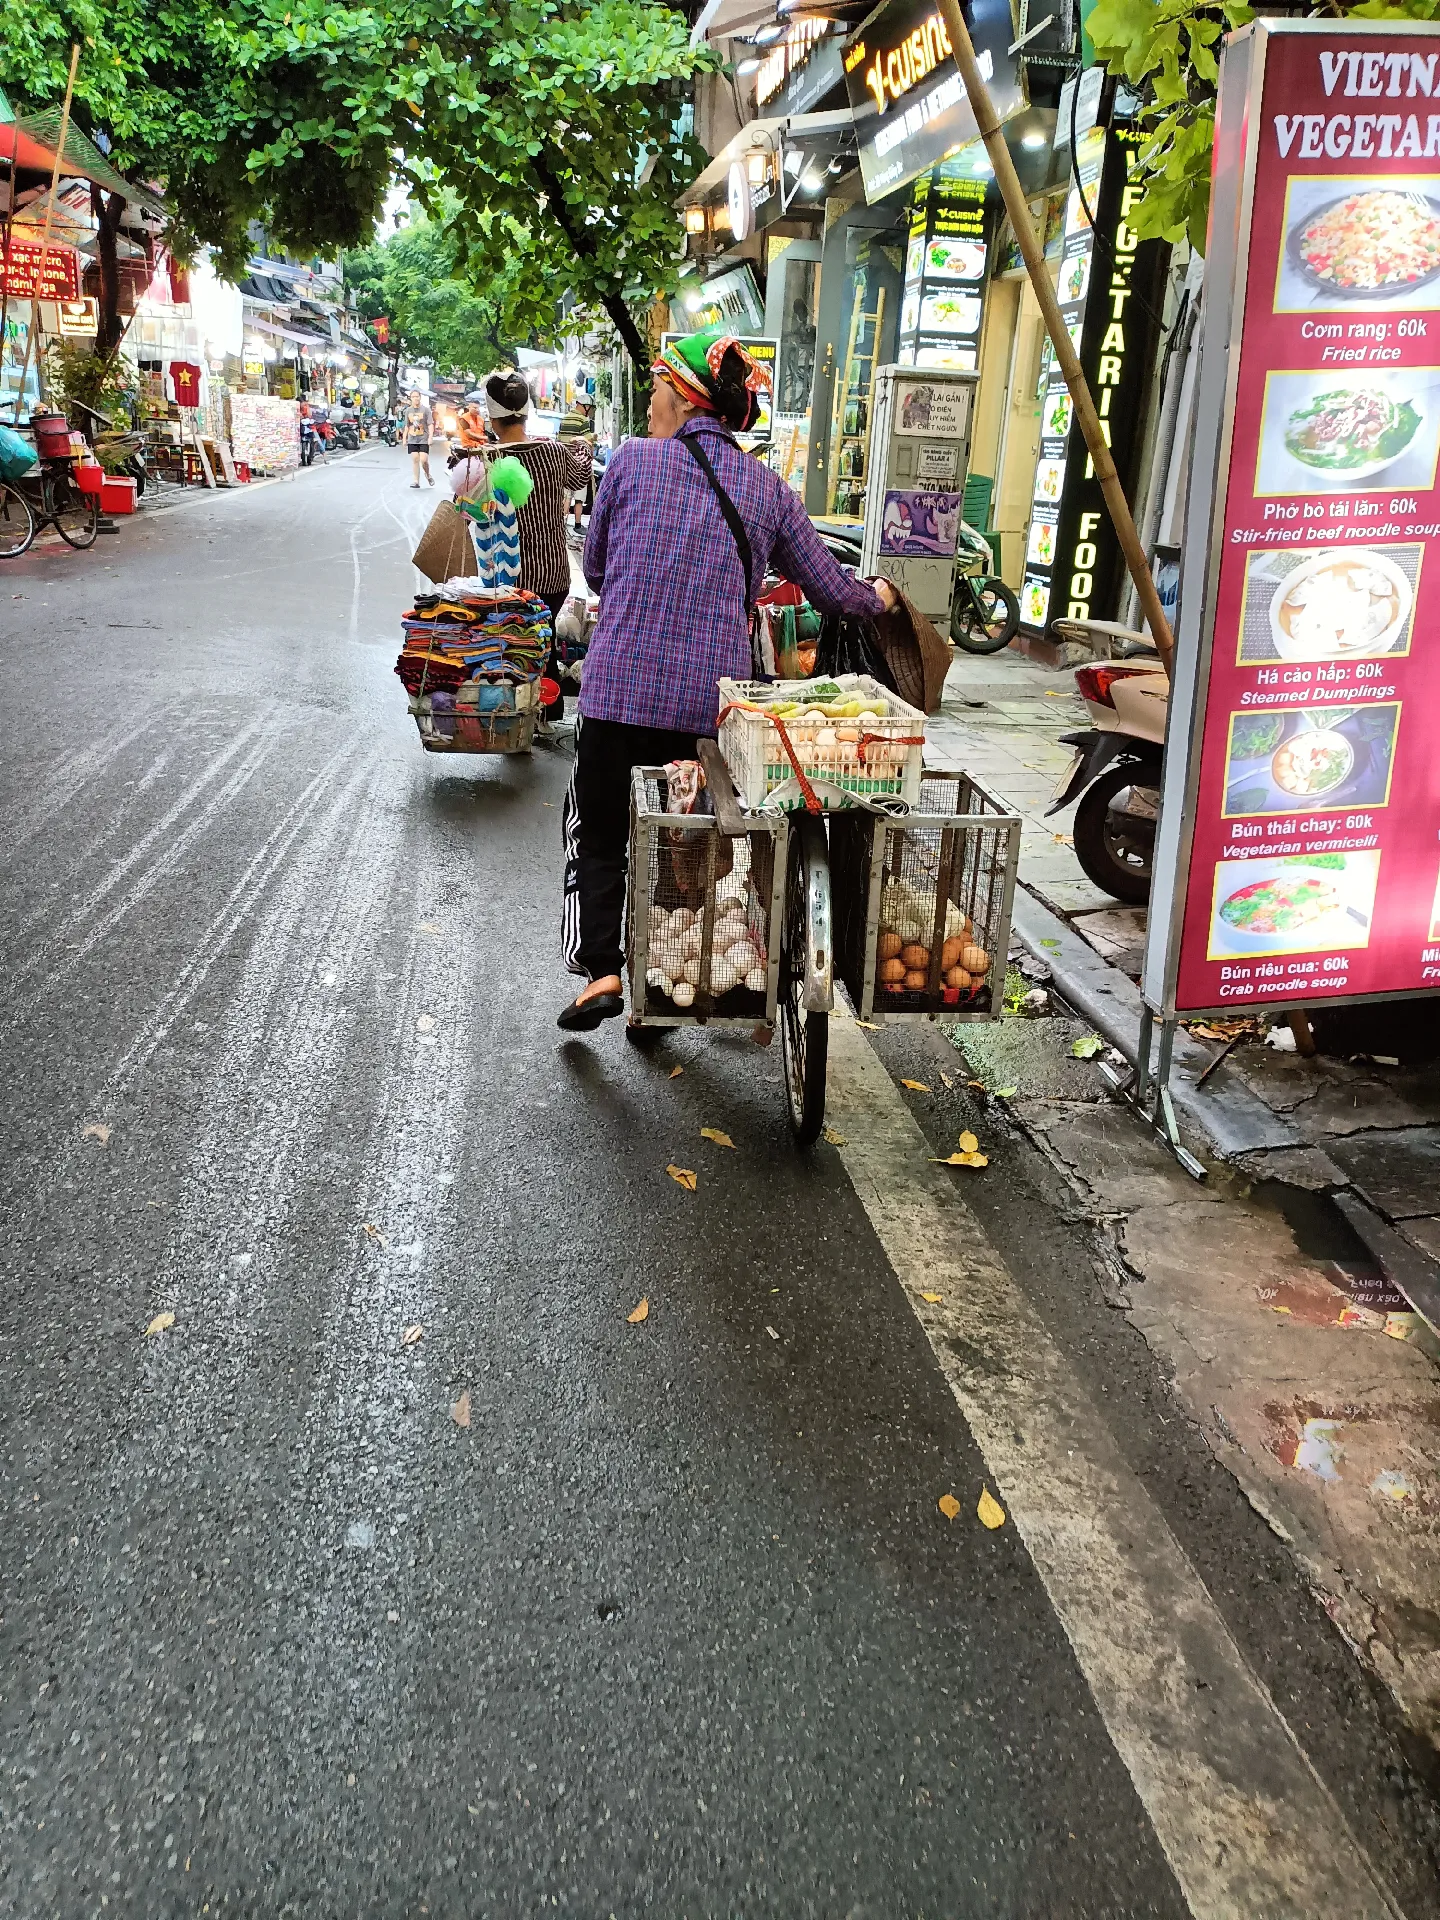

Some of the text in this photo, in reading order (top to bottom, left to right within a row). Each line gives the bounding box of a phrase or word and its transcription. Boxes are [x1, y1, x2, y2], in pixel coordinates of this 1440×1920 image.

[33, 255, 65, 268] mcro,
[1301, 318, 1428, 341] Cơm rang: 60k
[749, 346, 775, 359] MENU
[1322, 345, 1402, 361] Fried rice
[1263, 497, 1418, 520] Phở bò tái lăn: 60k
[1231, 527, 1303, 544] Stir-fried
[1306, 524, 1344, 541] beef
[1344, 522, 1400, 539] noodle
[1257, 662, 1384, 685] Há cảo hấp: 60k
[1240, 684, 1395, 705] Steamed Dumplings
[1231, 814, 1373, 838] Bún thái chay: 60k
[1223, 834, 1379, 860] Vegetarian vermicelli
[1421, 948, 1440, 963] Mi
[1221, 957, 1349, 980] Bún riêu cua: 60k
[1219, 976, 1348, 997] Crab noodle soup
